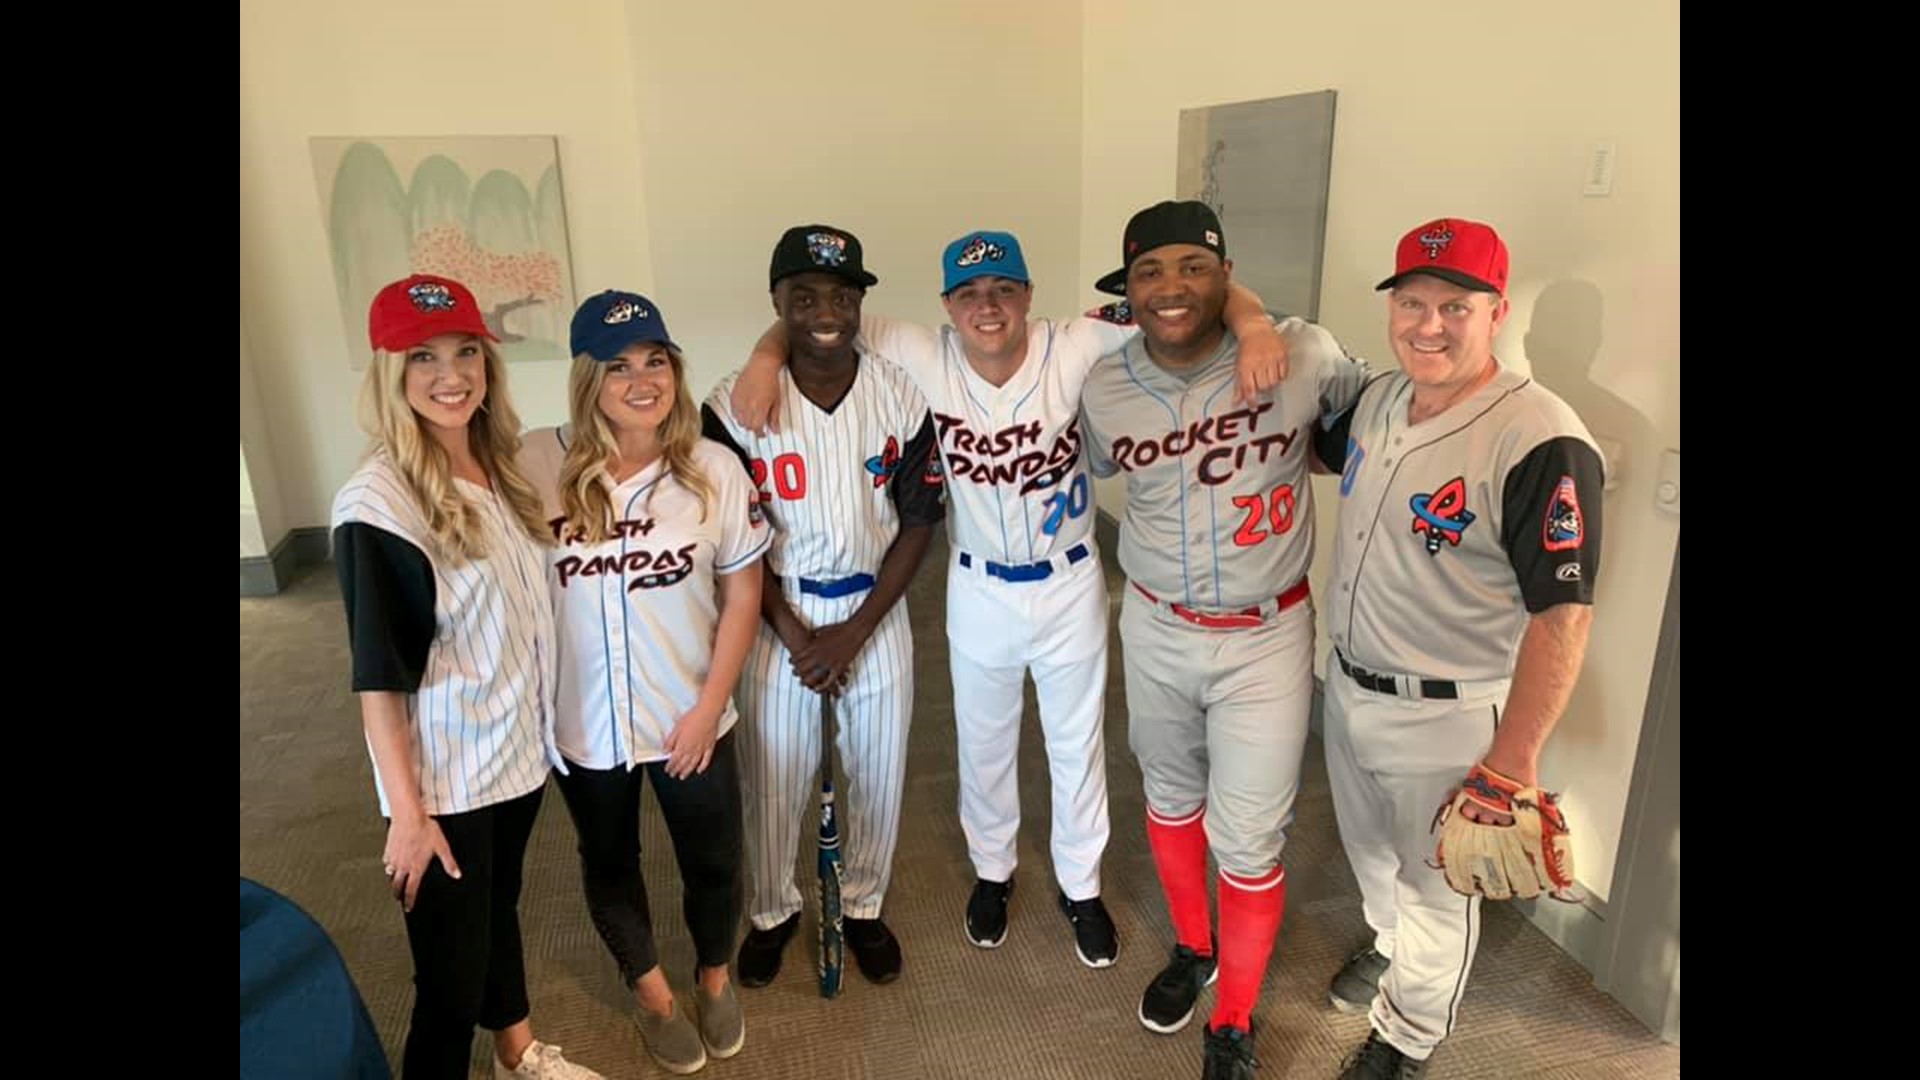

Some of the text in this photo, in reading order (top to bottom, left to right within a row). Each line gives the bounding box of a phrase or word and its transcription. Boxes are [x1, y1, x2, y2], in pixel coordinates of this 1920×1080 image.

[934, 413, 1043, 457] TRASH
[946, 415, 1080, 497] PANDAS
[1112, 402, 1274, 472] ROCKET
[1198, 428, 1297, 485] CITY
[548, 516, 656, 546] TRSH
[1042, 472, 1089, 536] 20
[1232, 483, 1295, 547] 20
[554, 543, 697, 593] PANDAS
